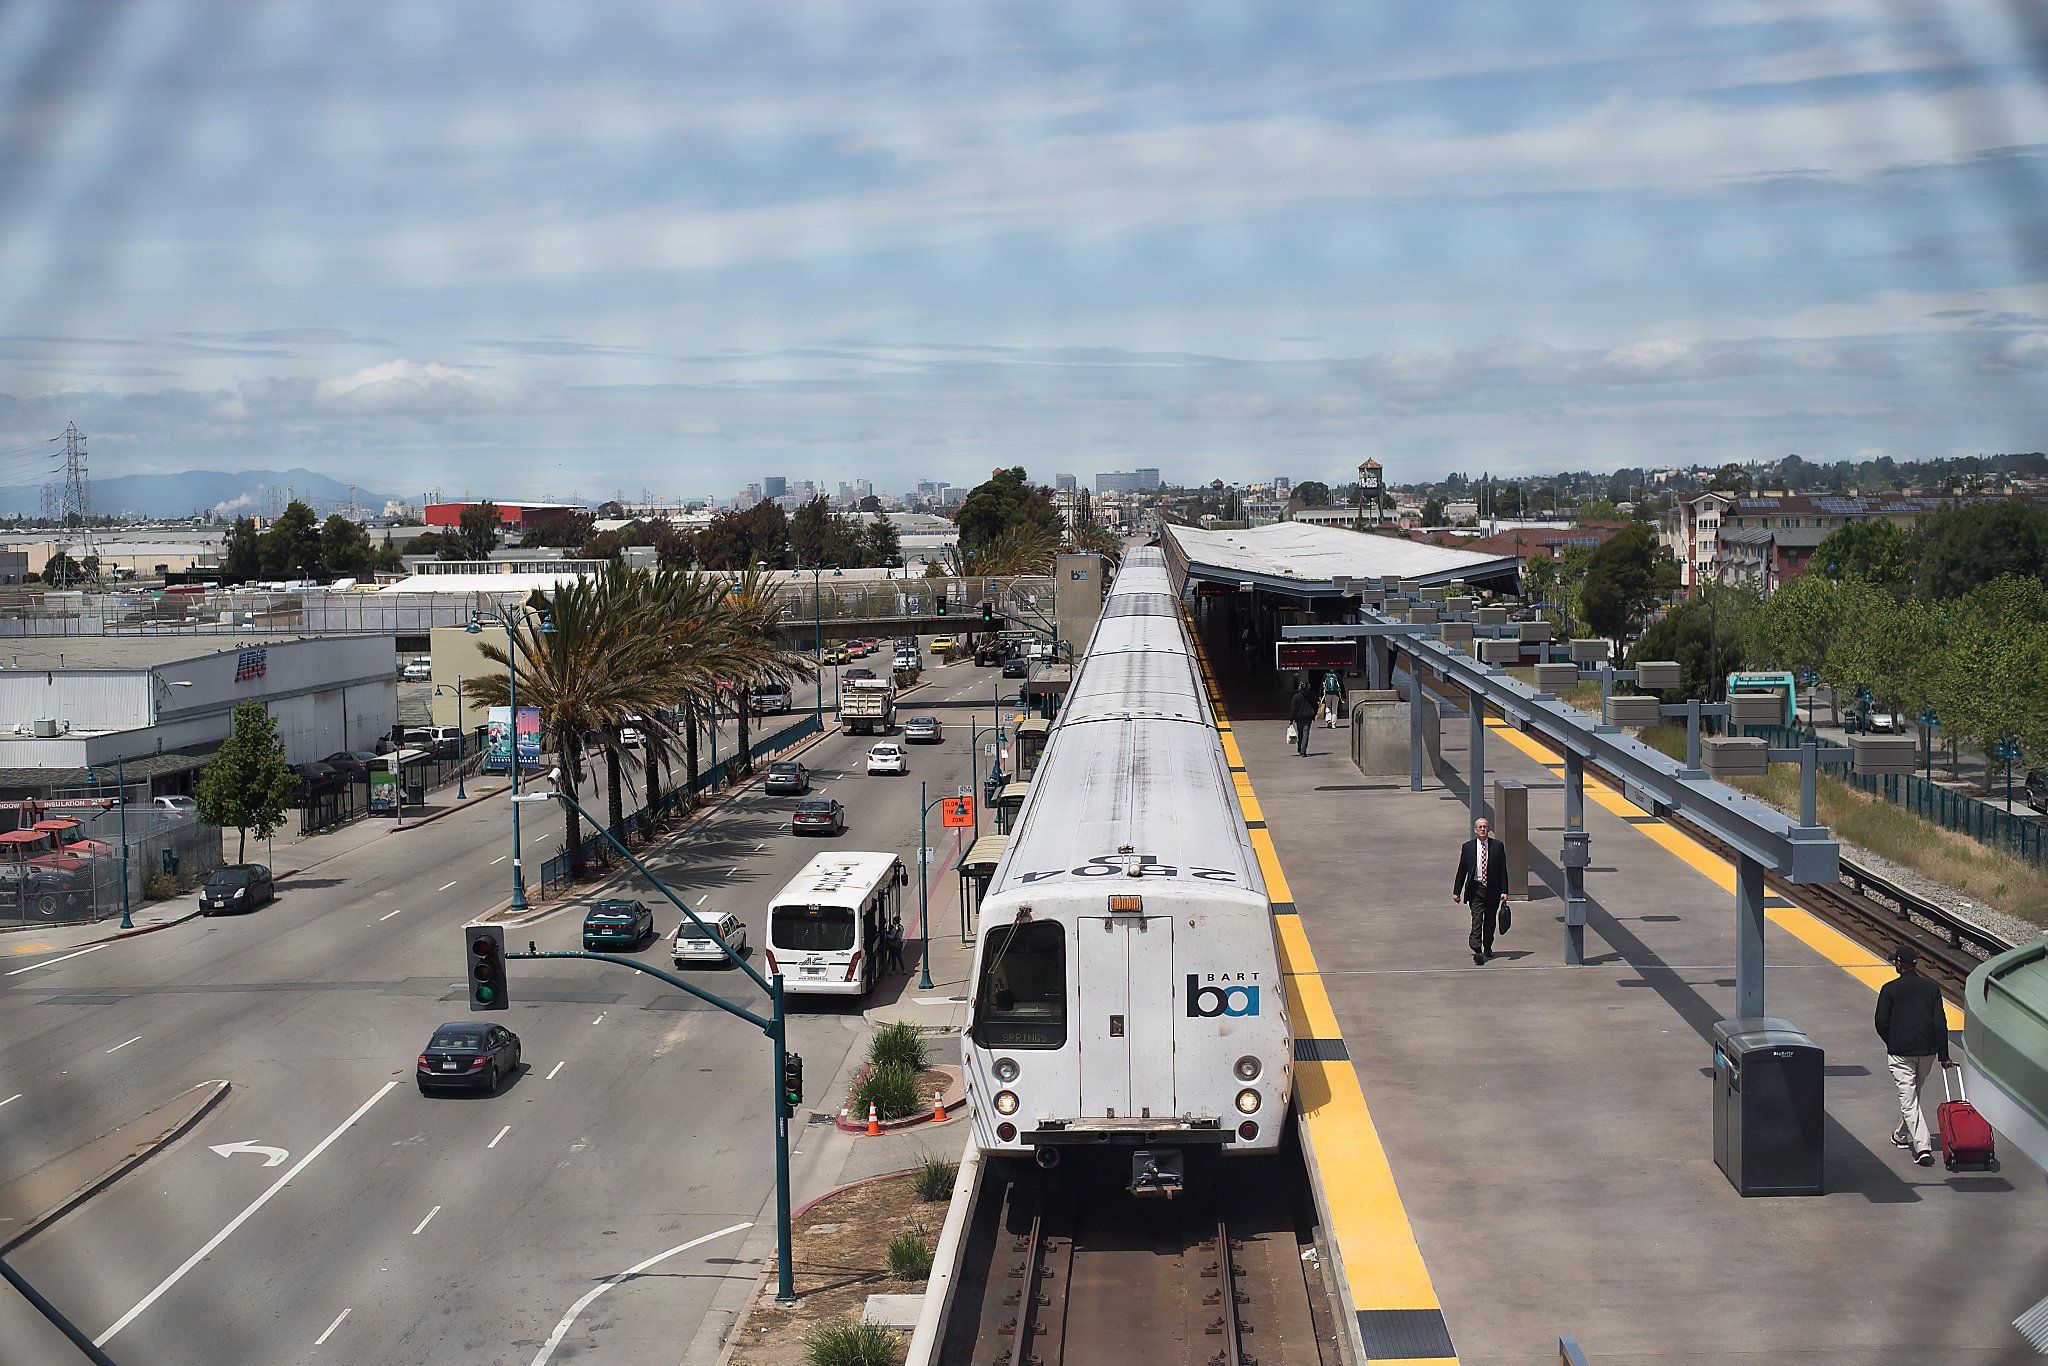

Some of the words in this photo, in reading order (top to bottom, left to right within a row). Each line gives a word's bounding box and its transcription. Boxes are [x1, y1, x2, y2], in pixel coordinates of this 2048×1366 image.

[44, 800, 85, 808] INSULATION
[1207, 972, 1260, 982] BART
[1003, 1033, 1048, 1043] SPRINGS
